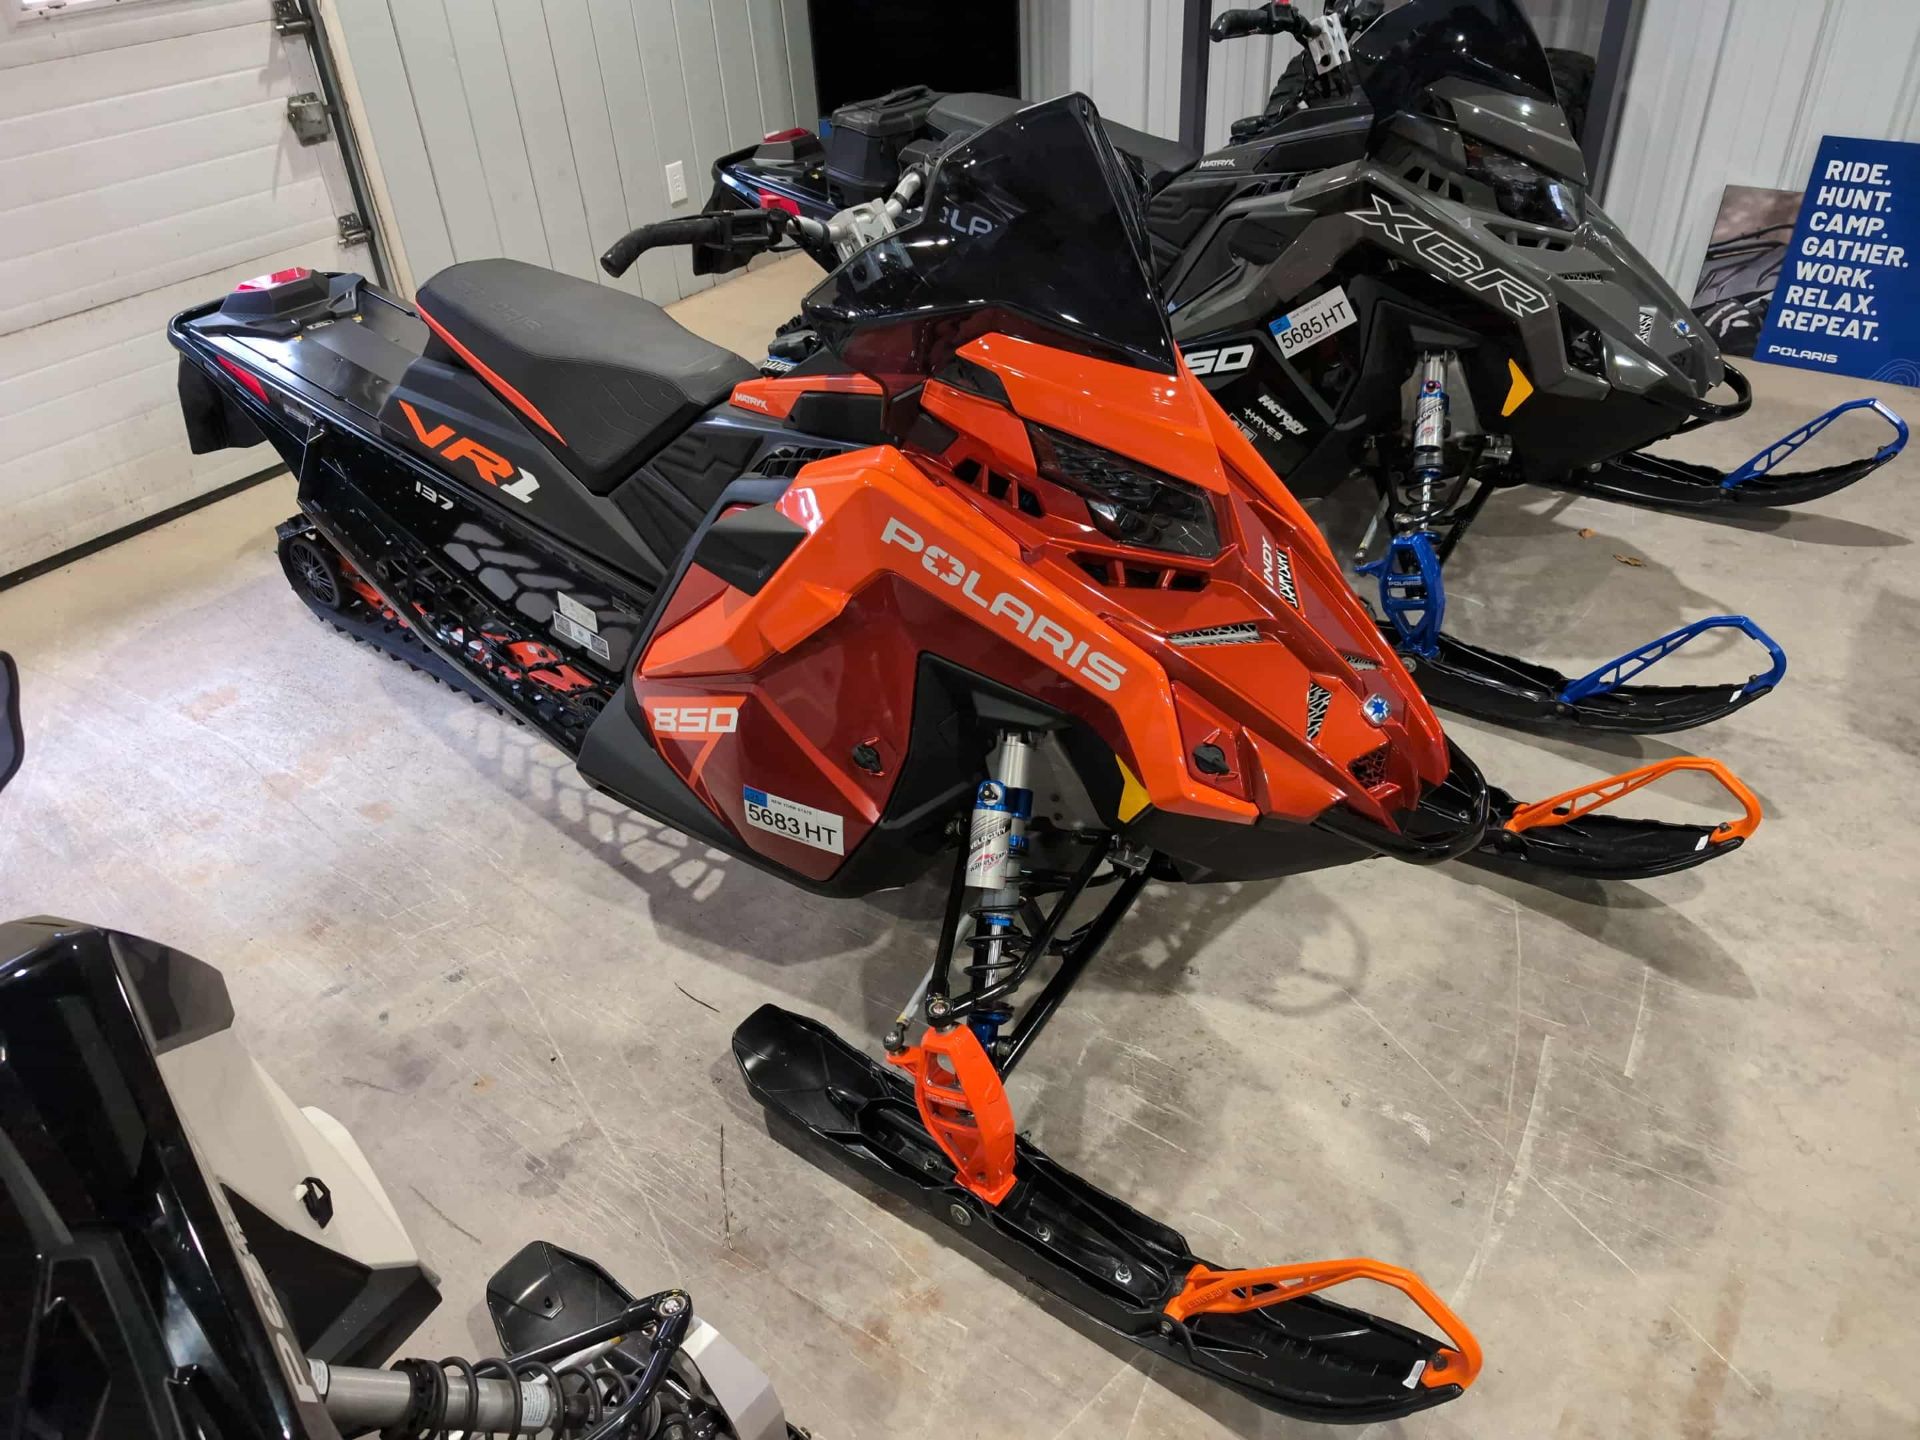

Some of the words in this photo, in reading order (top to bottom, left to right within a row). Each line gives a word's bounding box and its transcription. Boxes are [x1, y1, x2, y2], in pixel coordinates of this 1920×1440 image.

[1824, 159, 1891, 186] RIDE.
[1816, 186, 1892, 213] HUNT.
[1809, 211, 1889, 239] CAMP.
[1344, 193, 1550, 317] XCR
[1801, 236, 1909, 268] GATHER.
[1796, 260, 1875, 290] WORK.
[1785, 285, 1877, 316] RELAX.
[1281, 316, 1323, 350] 5685
[1321, 301, 1348, 328] HT
[1777, 309, 1879, 342] REPEAT.
[1768, 345, 1839, 364] POLARIS
[1246, 409, 1283, 441] HAYES
[398, 399, 541, 504] VR1
[415, 481, 454, 511] 137
[1262, 535, 1274, 587] INDY
[880, 517, 1128, 692] POLARIS
[653, 707, 739, 733] 850
[748, 803, 800, 835] 5683
[804, 822, 838, 846] HT
